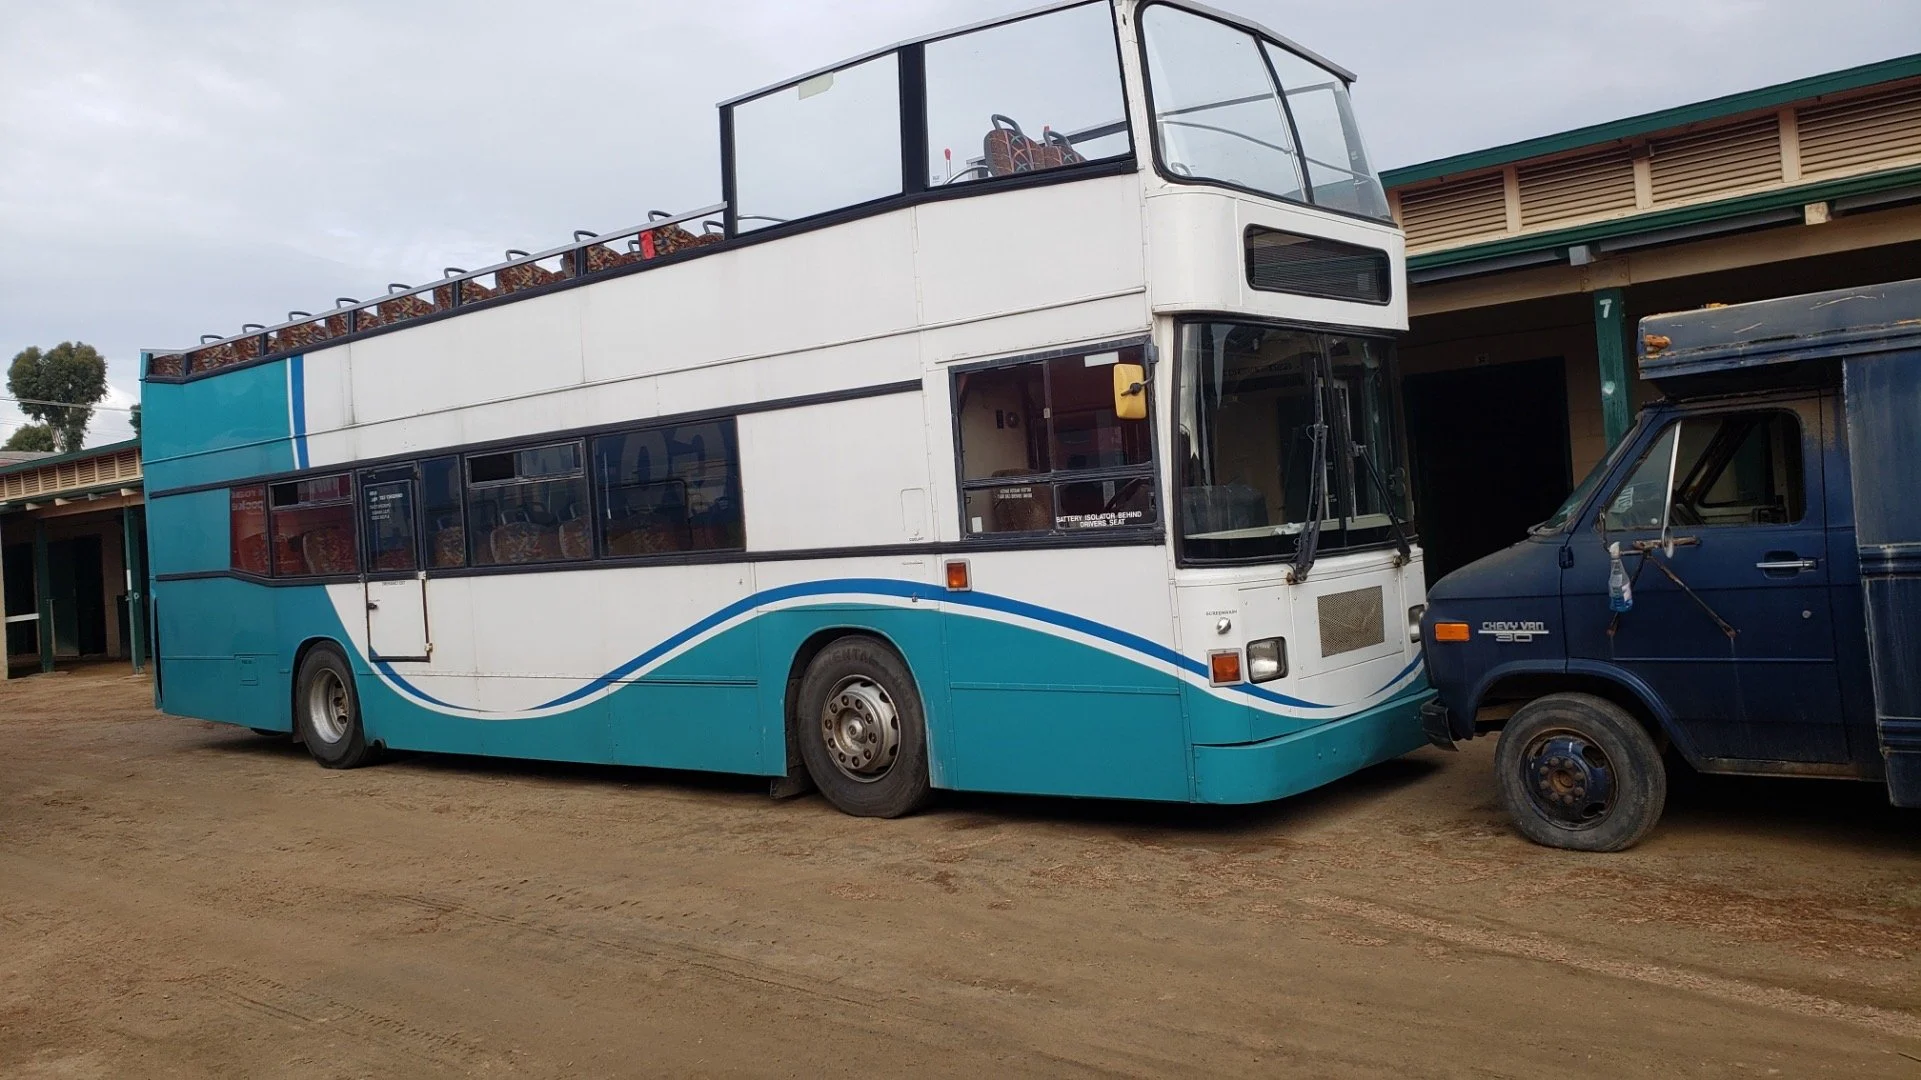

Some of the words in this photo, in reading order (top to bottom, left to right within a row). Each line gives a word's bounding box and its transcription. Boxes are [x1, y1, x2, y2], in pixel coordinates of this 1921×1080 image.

[1599, 298, 1612, 319] 7
[1084, 512, 1115, 520] ISOLATOR
[1080, 520, 1107, 528] DRIVERS
[1482, 621, 1519, 631] CHEVY
[1519, 621, 1545, 631] VAN
[1495, 633, 1533, 642] 30
